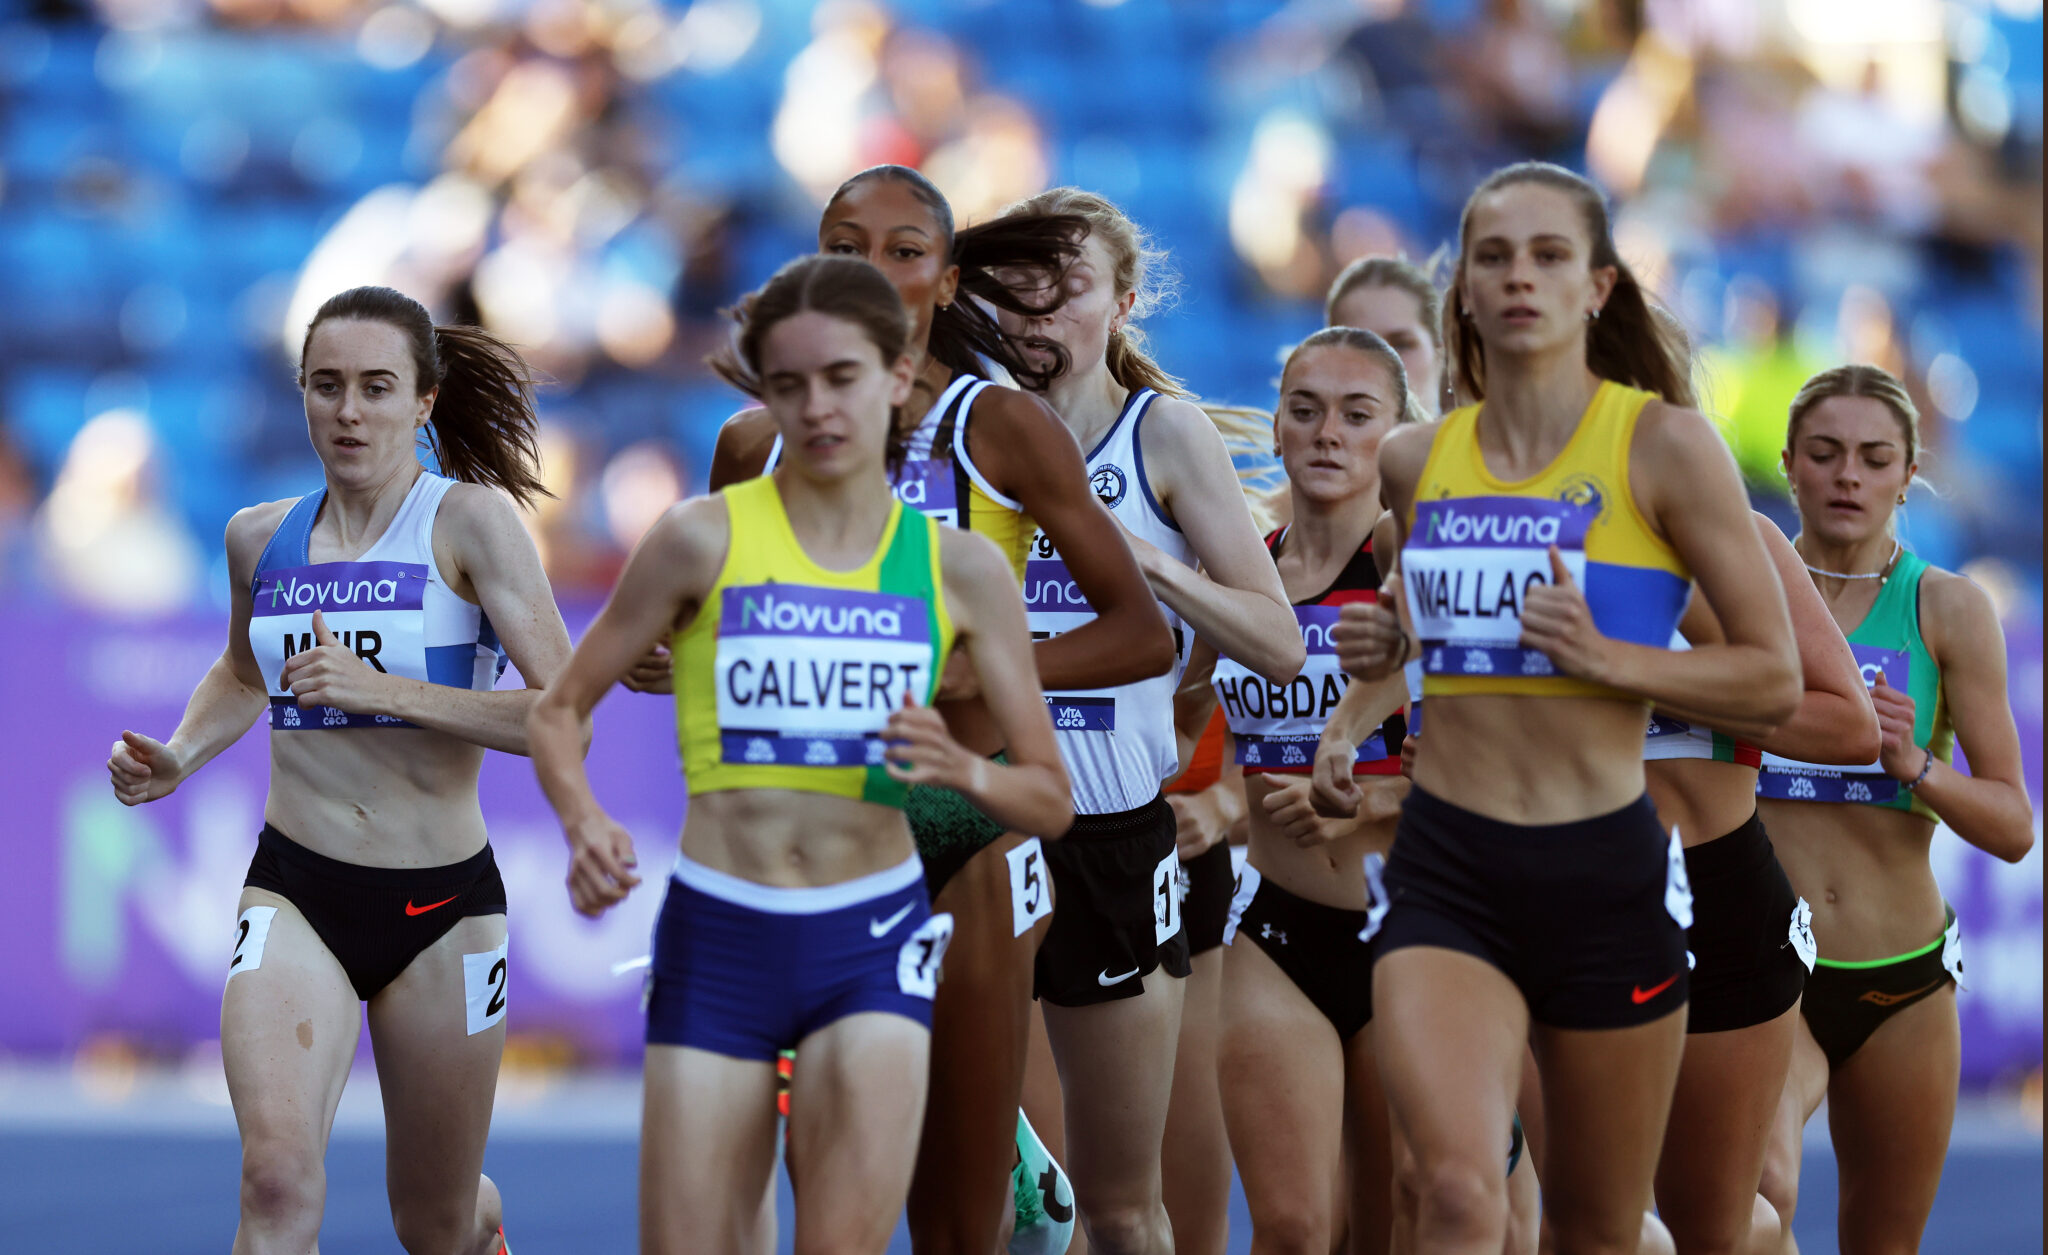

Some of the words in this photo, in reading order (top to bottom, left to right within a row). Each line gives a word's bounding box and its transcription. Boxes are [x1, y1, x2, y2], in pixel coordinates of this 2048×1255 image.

[1425, 506, 1560, 543] Novuna
[272, 577, 398, 608] Novuna
[741, 594, 902, 636] Novuna
[284, 630, 387, 673] MR
[728, 659, 919, 709] CALVERT
[284, 706, 299, 718] VITA
[1059, 706, 1083, 719] VITA
[284, 717, 301, 727] COCO
[323, 716, 348, 726] COCO
[1057, 718, 1086, 727] COCO
[1282, 744, 1303, 755] VITA
[1282, 754, 1307, 764] COCO
[1791, 776, 1814, 790] VITA
[1788, 788, 1817, 799] COCO
[1024, 852, 1041, 915] 5
[231, 919, 250, 970] 2
[485, 957, 507, 1018] 2
